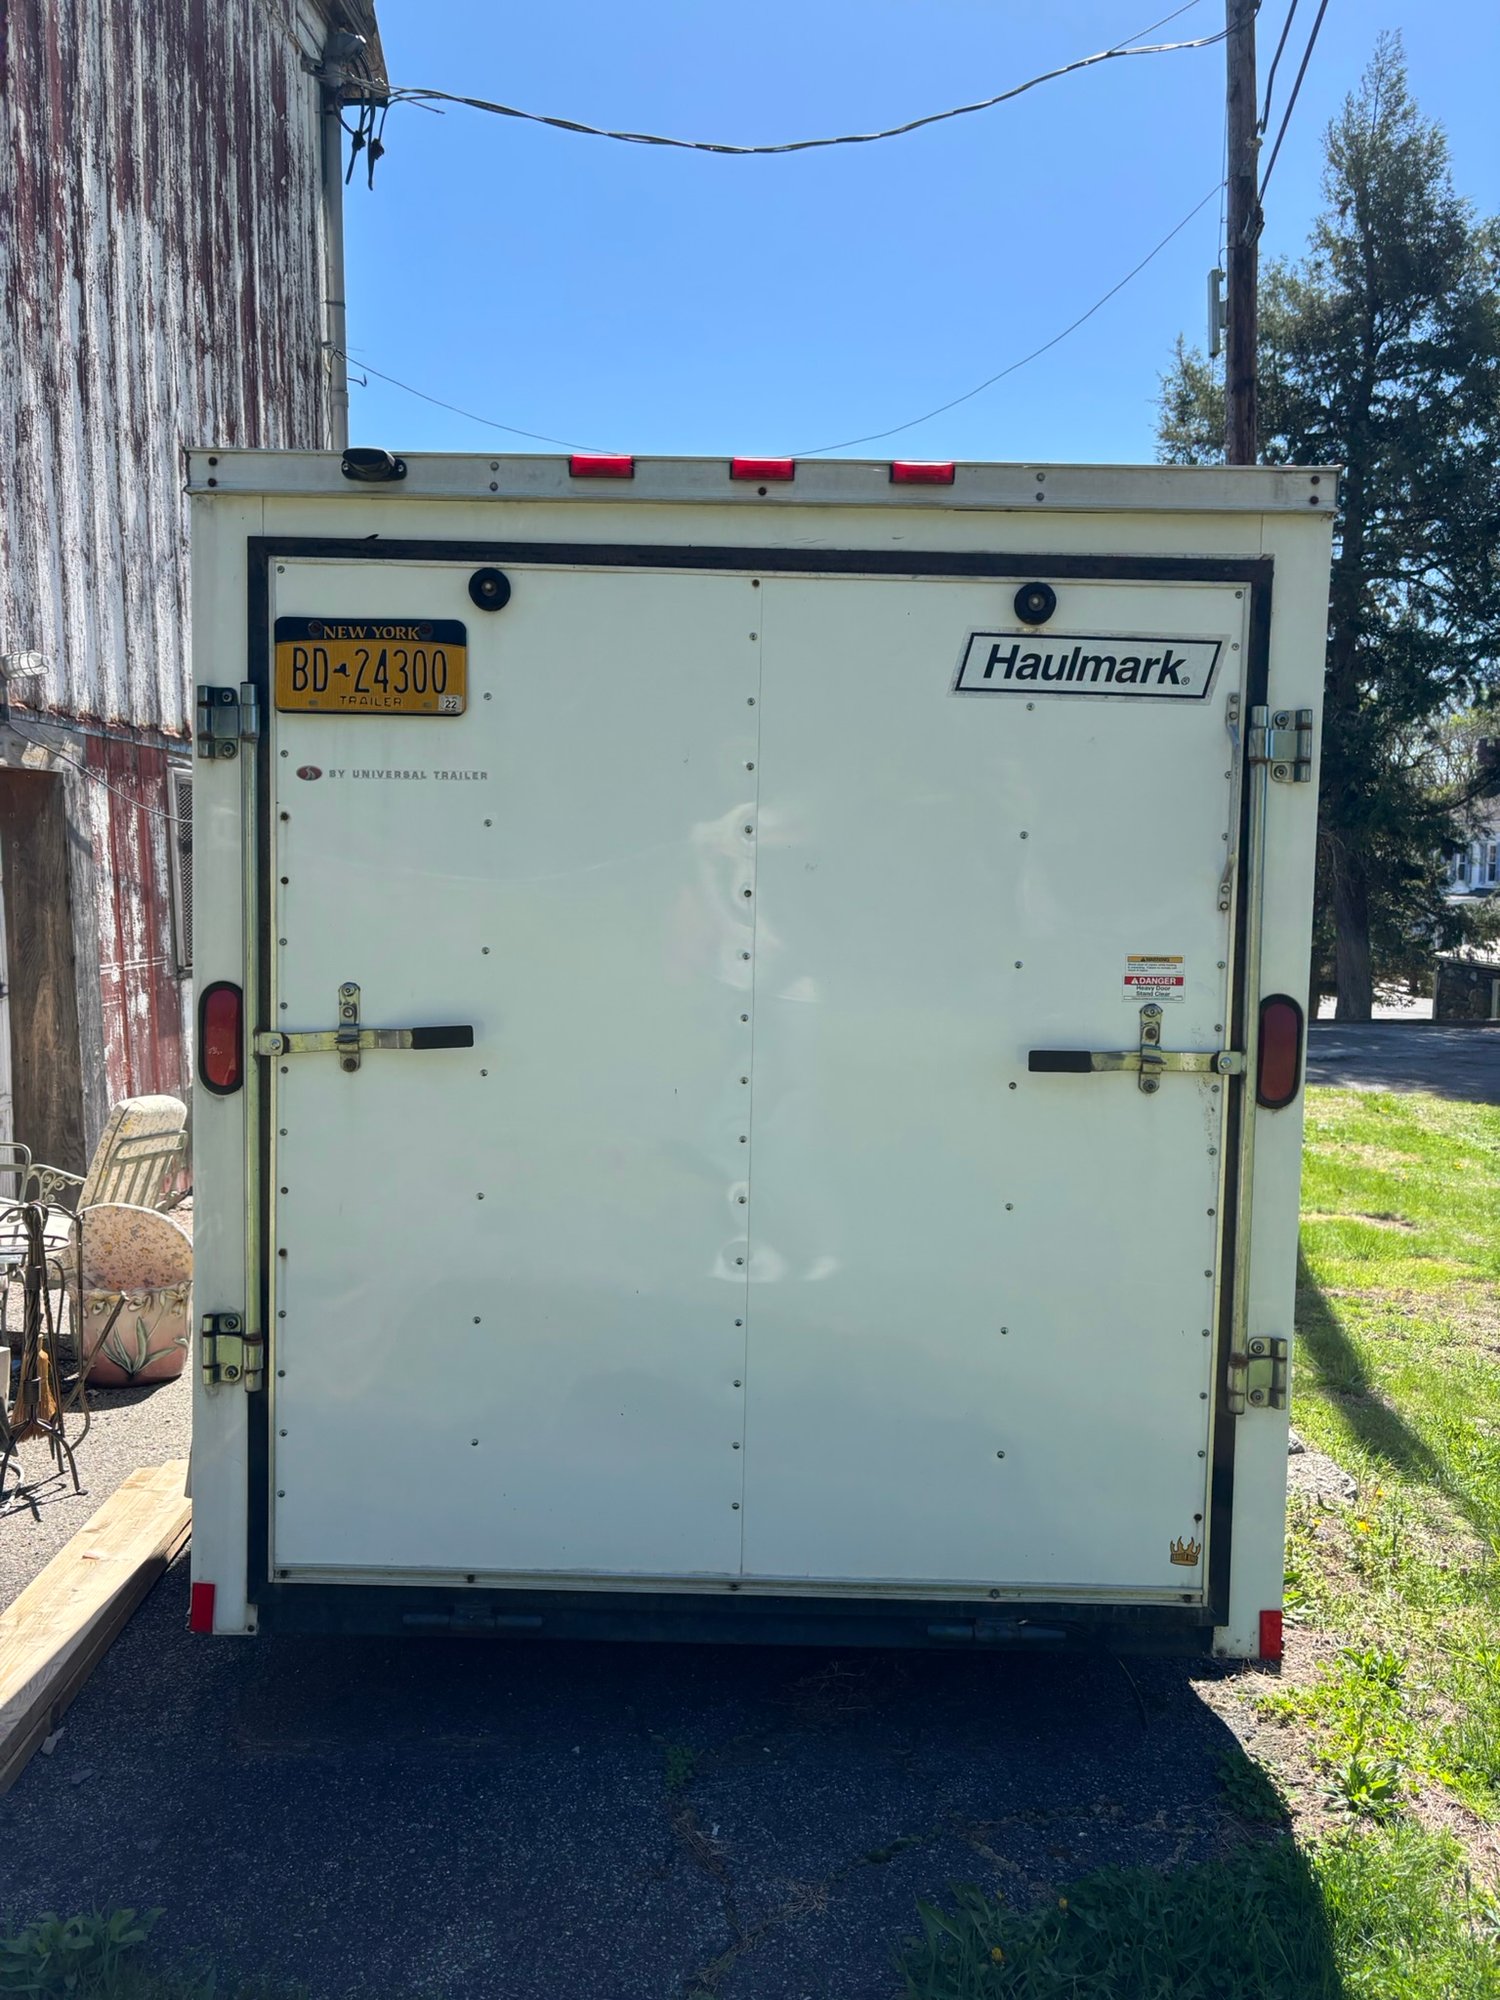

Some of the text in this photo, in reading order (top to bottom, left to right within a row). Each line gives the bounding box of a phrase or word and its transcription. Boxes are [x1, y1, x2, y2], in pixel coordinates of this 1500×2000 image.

[323, 626, 421, 640] NEW YORK
[339, 695, 402, 708] TRAILER
[445, 699, 457, 709] 22
[328, 769, 489, 781] BY UNIVERSAL TRAILER
